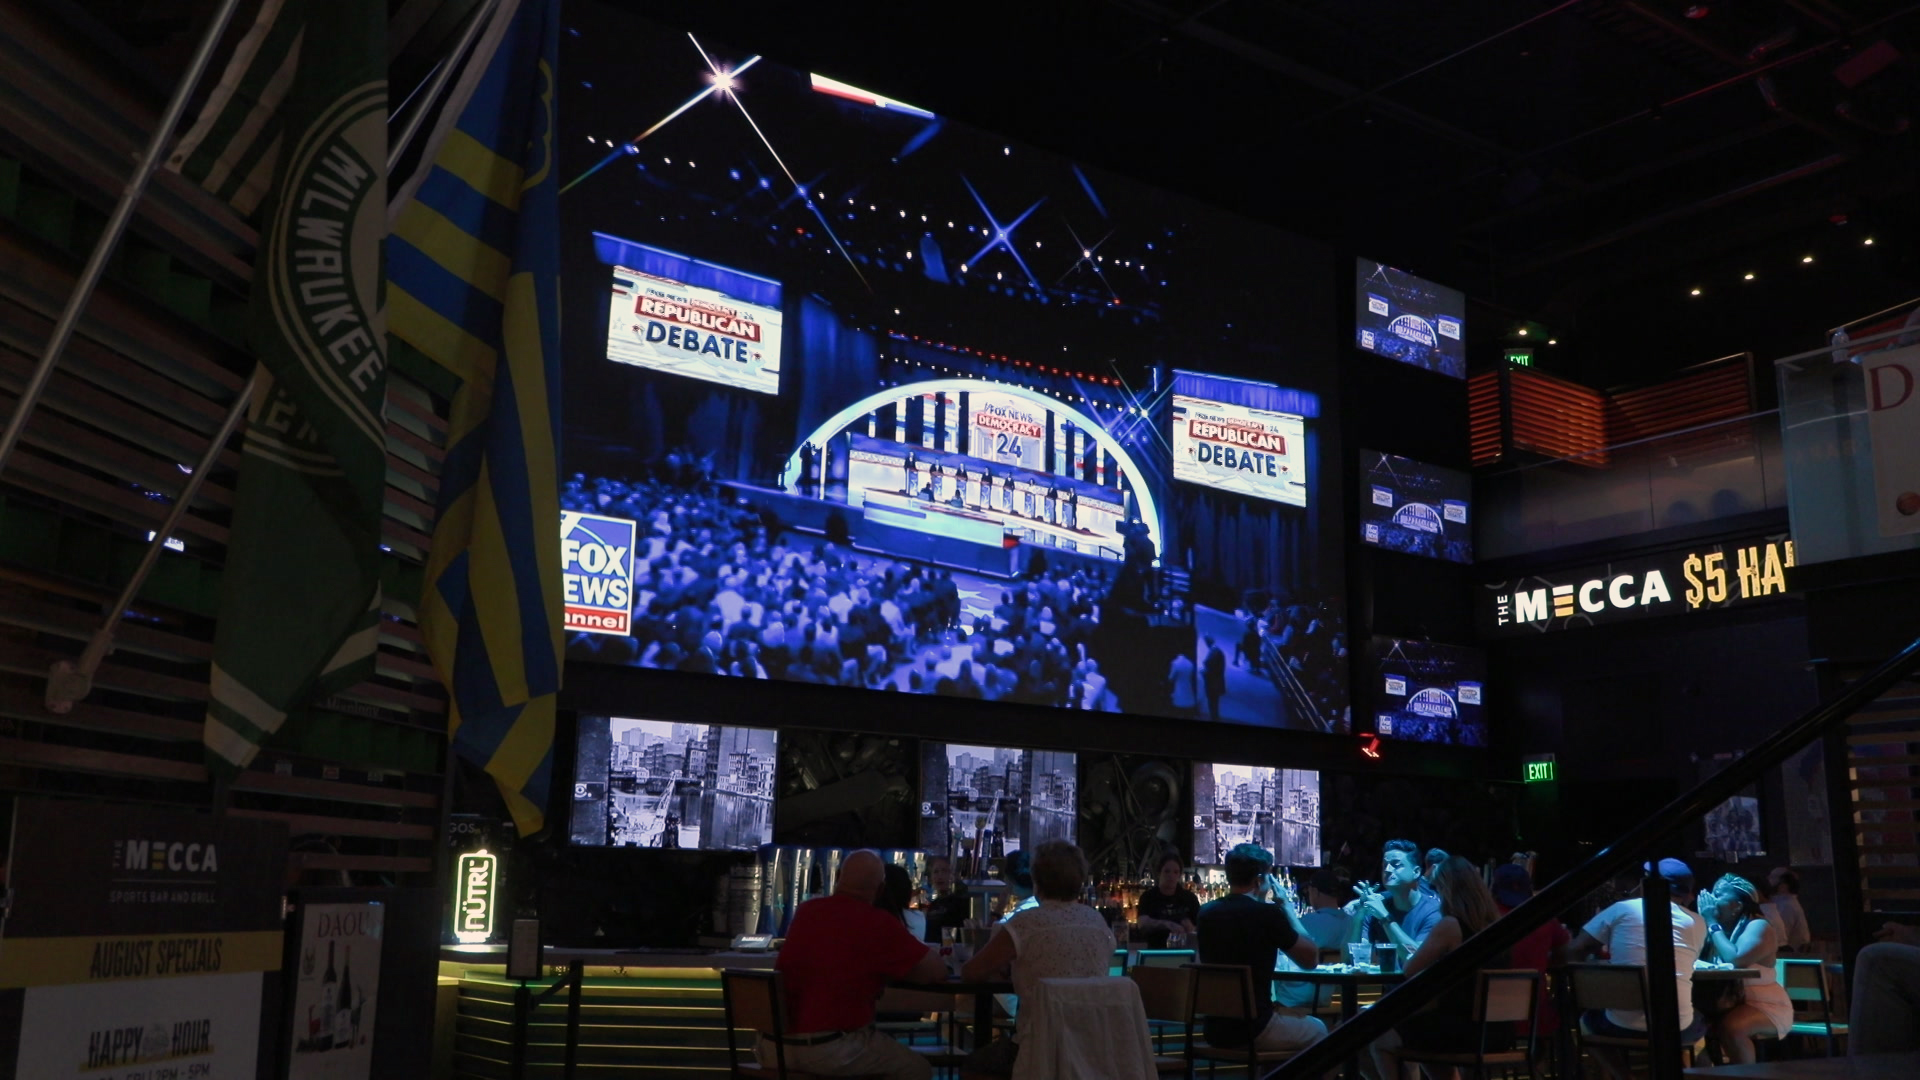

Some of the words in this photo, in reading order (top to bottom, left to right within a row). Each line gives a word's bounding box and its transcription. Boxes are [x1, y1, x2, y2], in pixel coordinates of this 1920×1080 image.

[295, 145, 384, 393] MILWAUKEE
[639, 299, 756, 339] REPUBLICAN
[645, 321, 748, 364] DEBATE
[978, 414, 1040, 437] DEMOCRACY
[989, 403, 1007, 418] FOX
[1008, 410, 1033, 424] NEWS
[997, 433, 1023, 458] 24
[1192, 421, 1281, 452] REPUBLICAN
[1198, 441, 1277, 478] DEBATE
[561, 538, 628, 578] FOX
[563, 573, 629, 608] EWS
[1514, 569, 1672, 624] MECCA
[1683, 552, 1727, 609] $5
[1497, 594, 1509, 626] THE
[1528, 763, 1548, 780] EXIT
[124, 839, 219, 873] MECCA
[109, 889, 149, 904] SPORTS
[150, 890, 168, 904] BAR
[170, 891, 189, 904] AND
[191, 891, 216, 904] GRILL
[90, 941, 153, 979] AUGUST
[156, 938, 222, 976] SPECIALS
[87, 1026, 144, 1069] HAPPY
[171, 1018, 210, 1057] HOUR
[188, 1062, 210, 1078] 5PM
